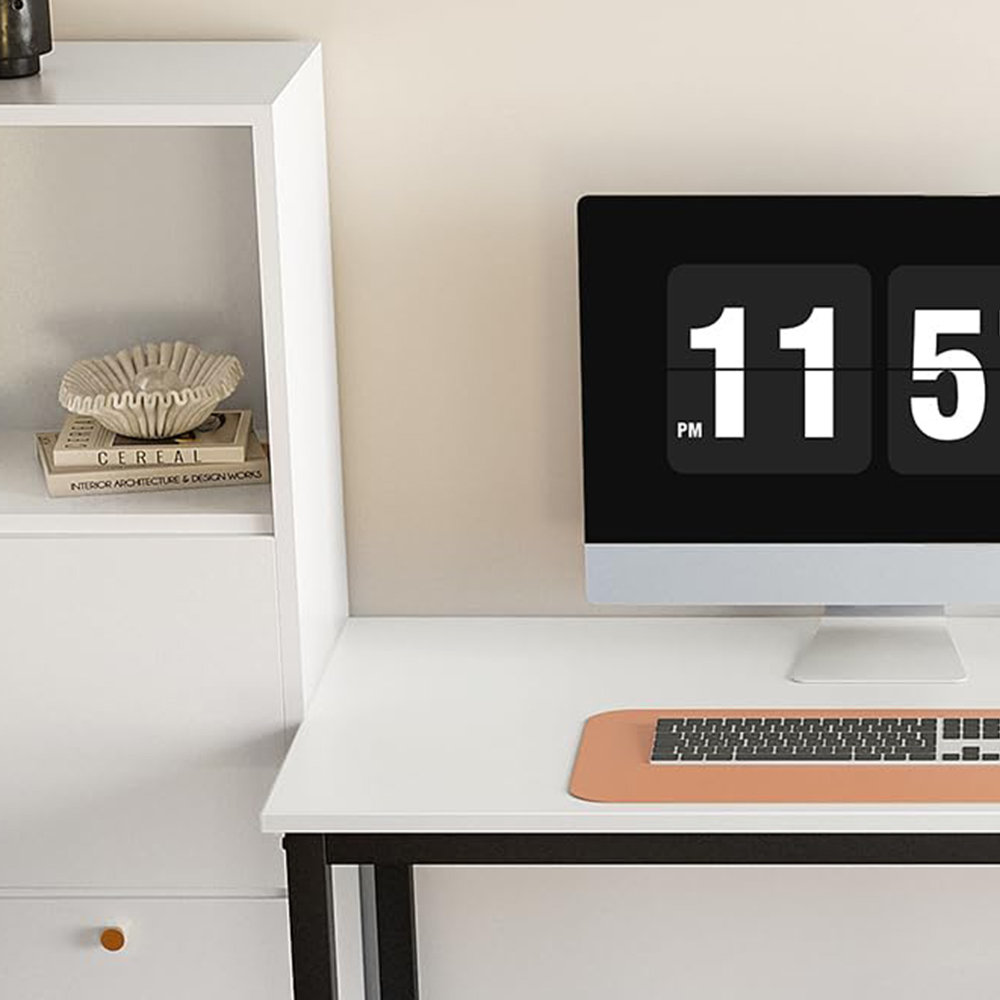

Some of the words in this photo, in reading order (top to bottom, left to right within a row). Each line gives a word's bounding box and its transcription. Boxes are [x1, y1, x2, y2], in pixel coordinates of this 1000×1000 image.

[690, 306, 834, 438] 11
[677, 422, 703, 438] PM
[97, 450, 202, 466] CEREAL
[70, 481, 112, 491] INTERIOR
[113, 474, 180, 488] ARCHITECTURE
[182, 473, 189, 483] &
[191, 471, 226, 483] DESIGN
[227, 470, 262, 481] WORKS
